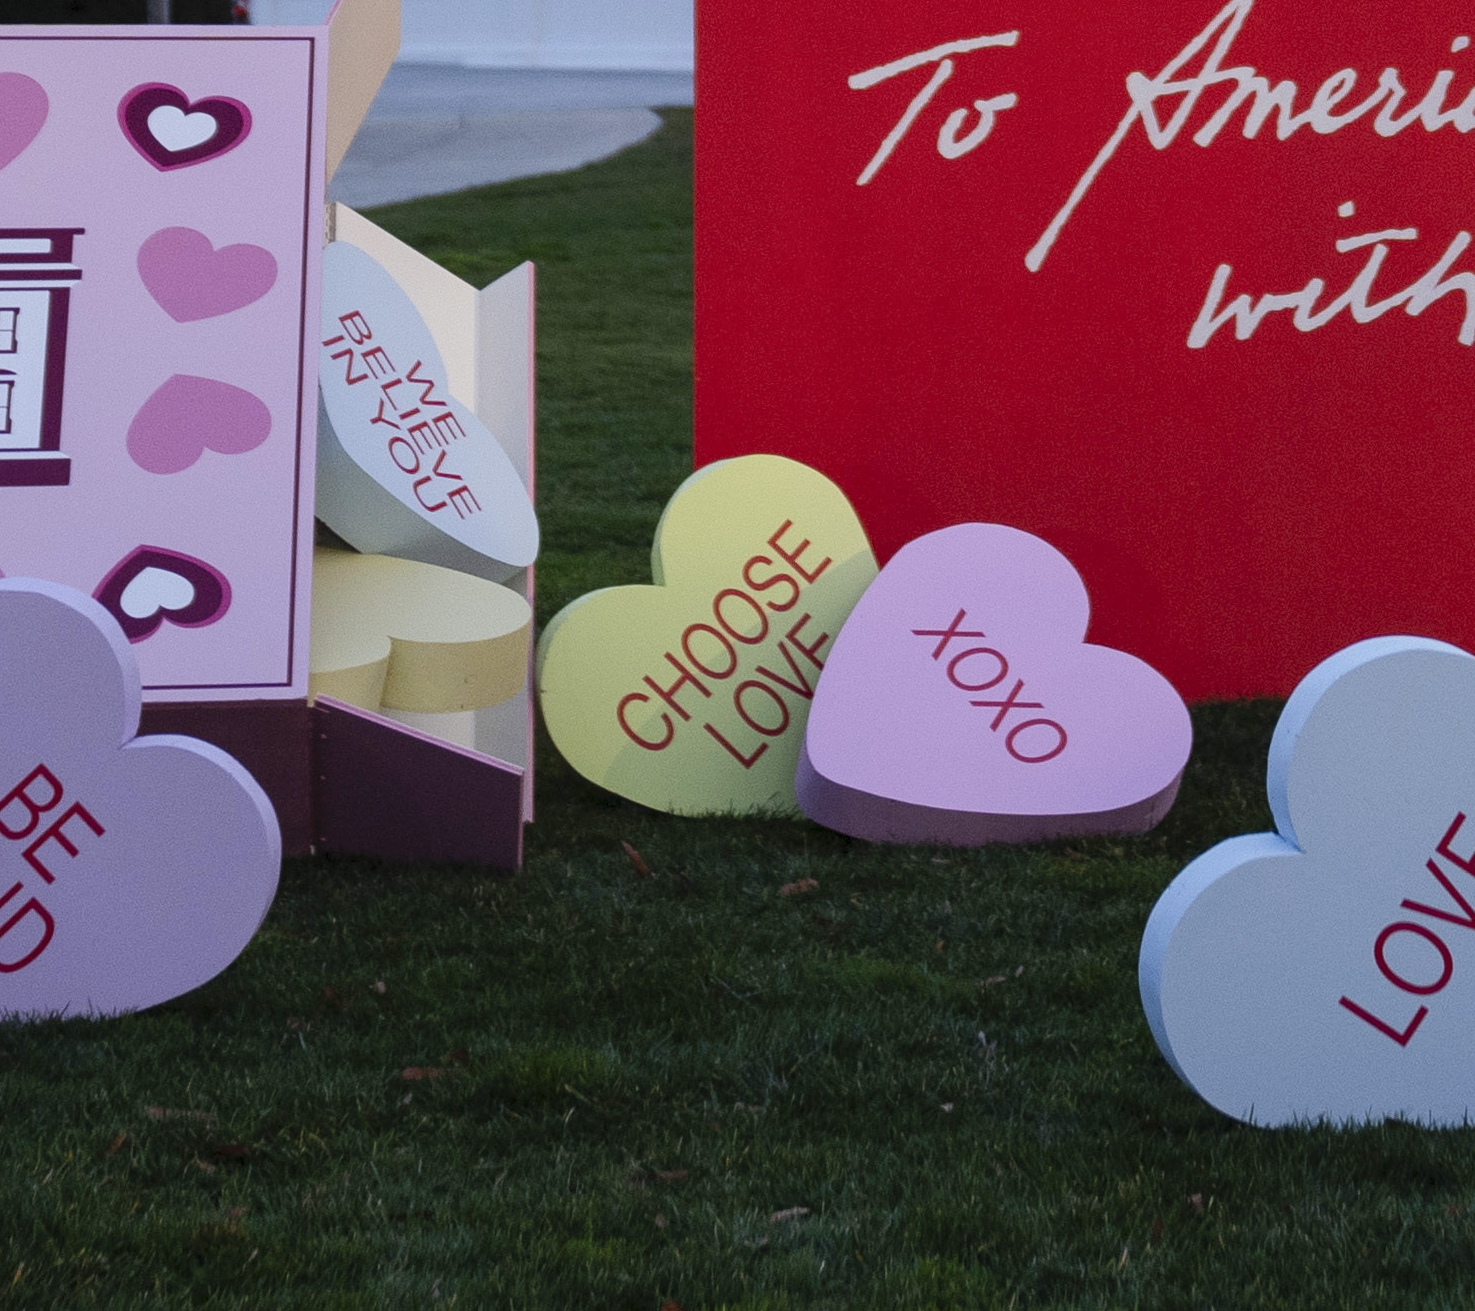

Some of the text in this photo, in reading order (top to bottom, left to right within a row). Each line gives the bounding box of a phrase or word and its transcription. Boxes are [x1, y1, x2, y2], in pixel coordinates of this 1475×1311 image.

[848, 30, 1019, 186] To
[321, 334, 448, 513] IN YOU
[338, 309, 482, 520] BELIEVE
[405, 359, 467, 446] WE
[616, 519, 832, 752] CHOOSE
[703, 612, 830, 770] LOVE
[911, 607, 1069, 765] XOXO
